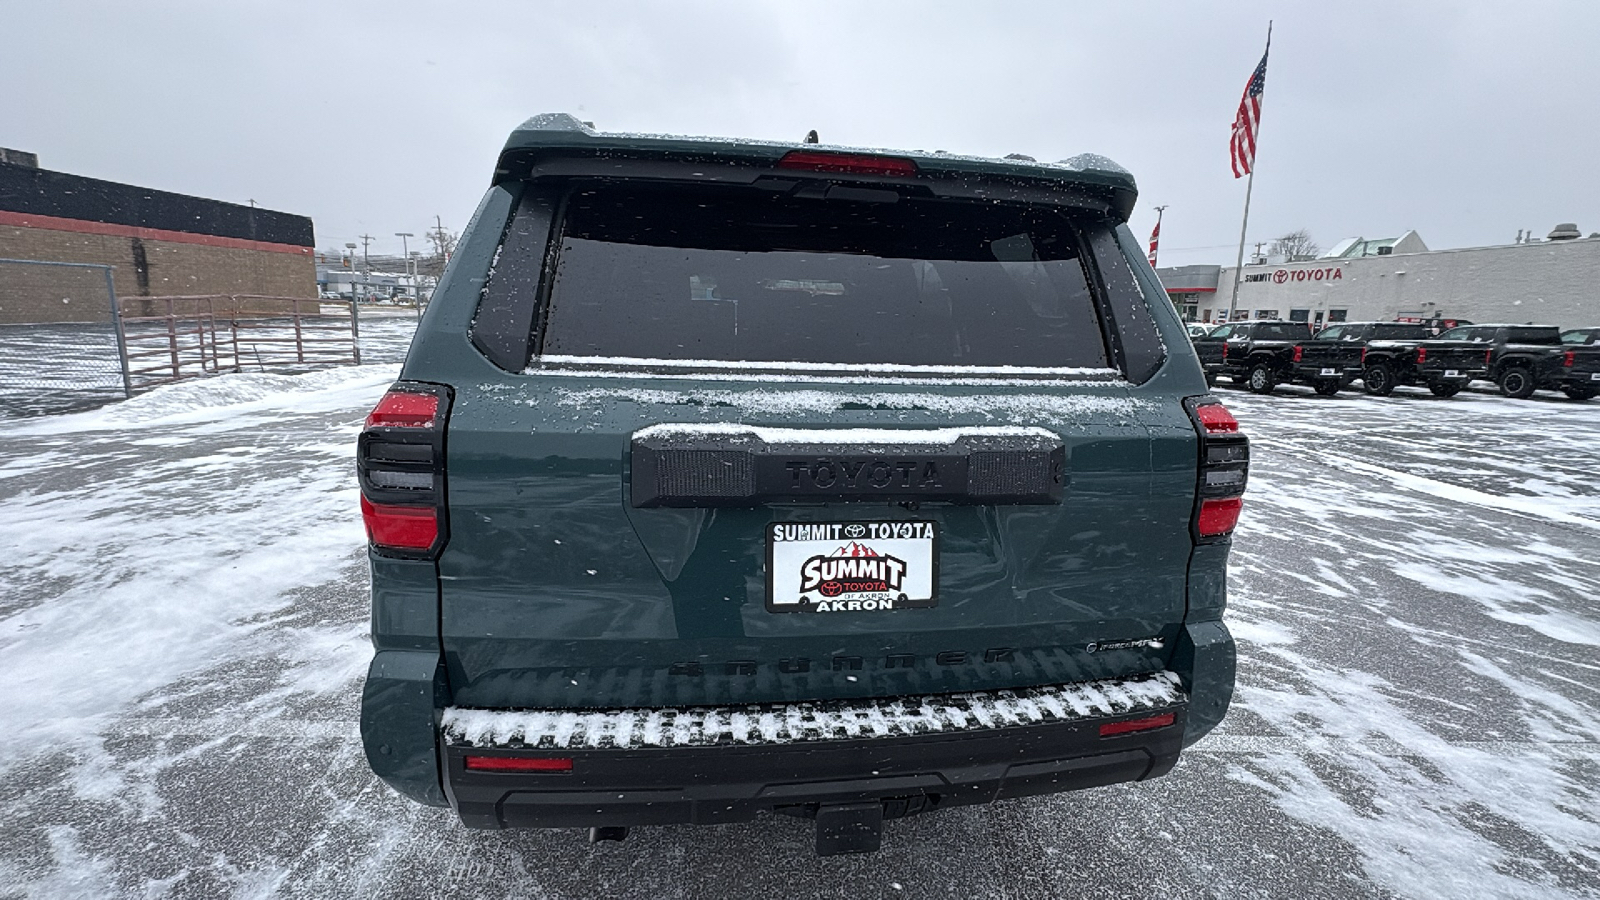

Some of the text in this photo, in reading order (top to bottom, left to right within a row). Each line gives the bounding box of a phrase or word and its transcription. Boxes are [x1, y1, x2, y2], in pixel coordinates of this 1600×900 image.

[1245, 268, 1342, 283] SUMMIT TOYOTA
[785, 461, 943, 489] TOYOTA
[773, 522, 934, 541] SUMMIT TOYOTA
[804, 558, 903, 590] SUMMIT
[843, 582, 888, 591] TOYOTA
[816, 599, 893, 612] AKRON
